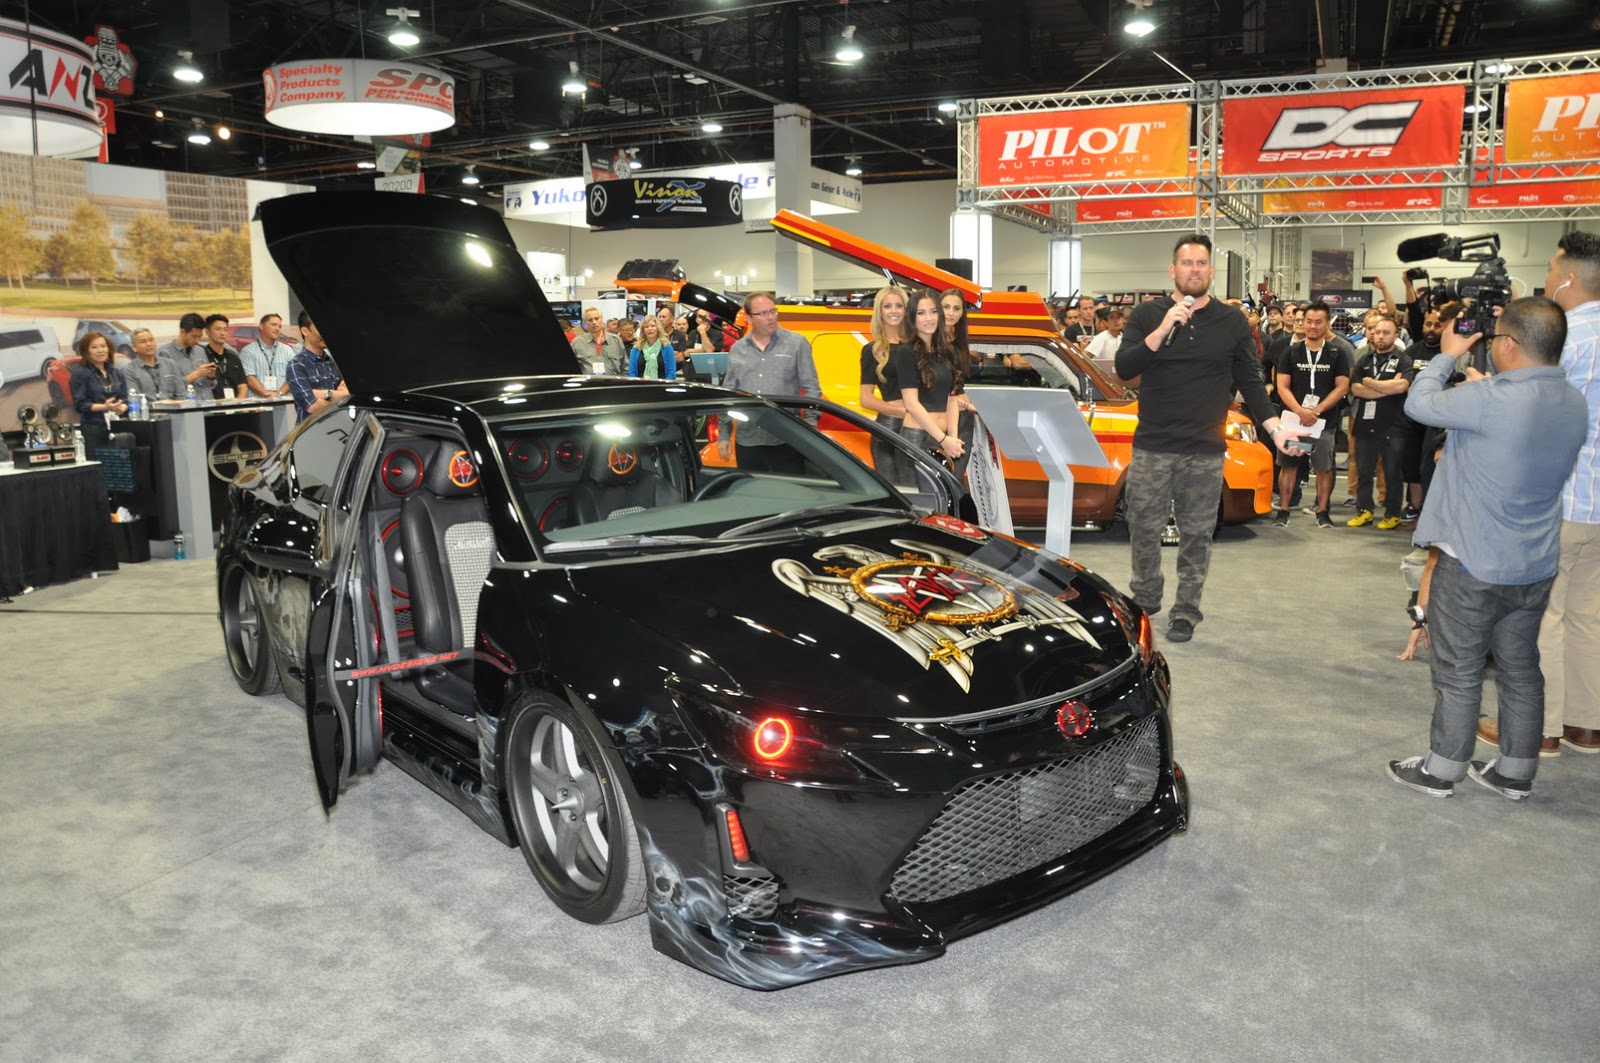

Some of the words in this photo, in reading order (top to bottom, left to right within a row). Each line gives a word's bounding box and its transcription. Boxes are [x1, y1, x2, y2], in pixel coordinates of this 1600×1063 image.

[279, 64, 343, 79] Specialty
[280, 77, 341, 91] Products
[280, 90, 343, 103] Company
[364, 88, 454, 112] PERFORMANC
[1532, 93, 1600, 133] PI
[1261, 100, 1424, 150] DC
[999, 122, 1151, 161] PILOT
[998, 154, 1151, 170] AUTOMOTIVE
[1257, 146, 1393, 163] SPORTS
[634, 180, 698, 198] Vision
[821, 182, 835, 193] Gear
[532, 188, 586, 205] Yuko
